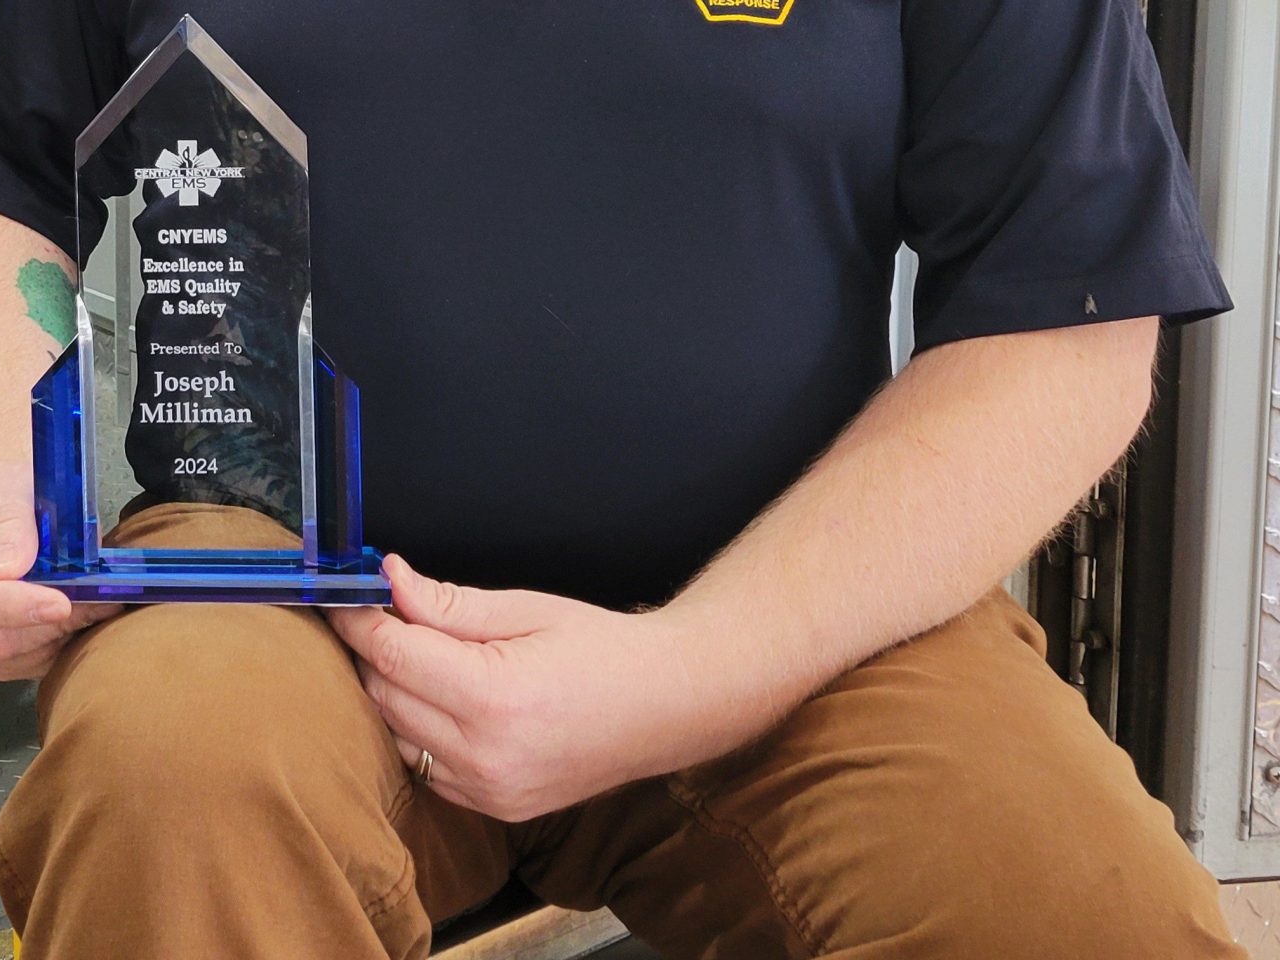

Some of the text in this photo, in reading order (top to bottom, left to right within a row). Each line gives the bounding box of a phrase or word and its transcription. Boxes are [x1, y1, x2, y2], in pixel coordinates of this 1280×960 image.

[134, 168, 243, 178] CENTRAL NEW YORK
[171, 178, 207, 189] EMS
[157, 229, 228, 244] CNYEMS
[143, 258, 245, 273] Excellence in
[146, 279, 241, 296] EMS Quality
[161, 300, 227, 318] & Safety
[150, 343, 243, 355] Presented To
[154, 371, 236, 397] Joseph
[140, 403, 253, 424] Milliman
[174, 458, 219, 475] 2024
